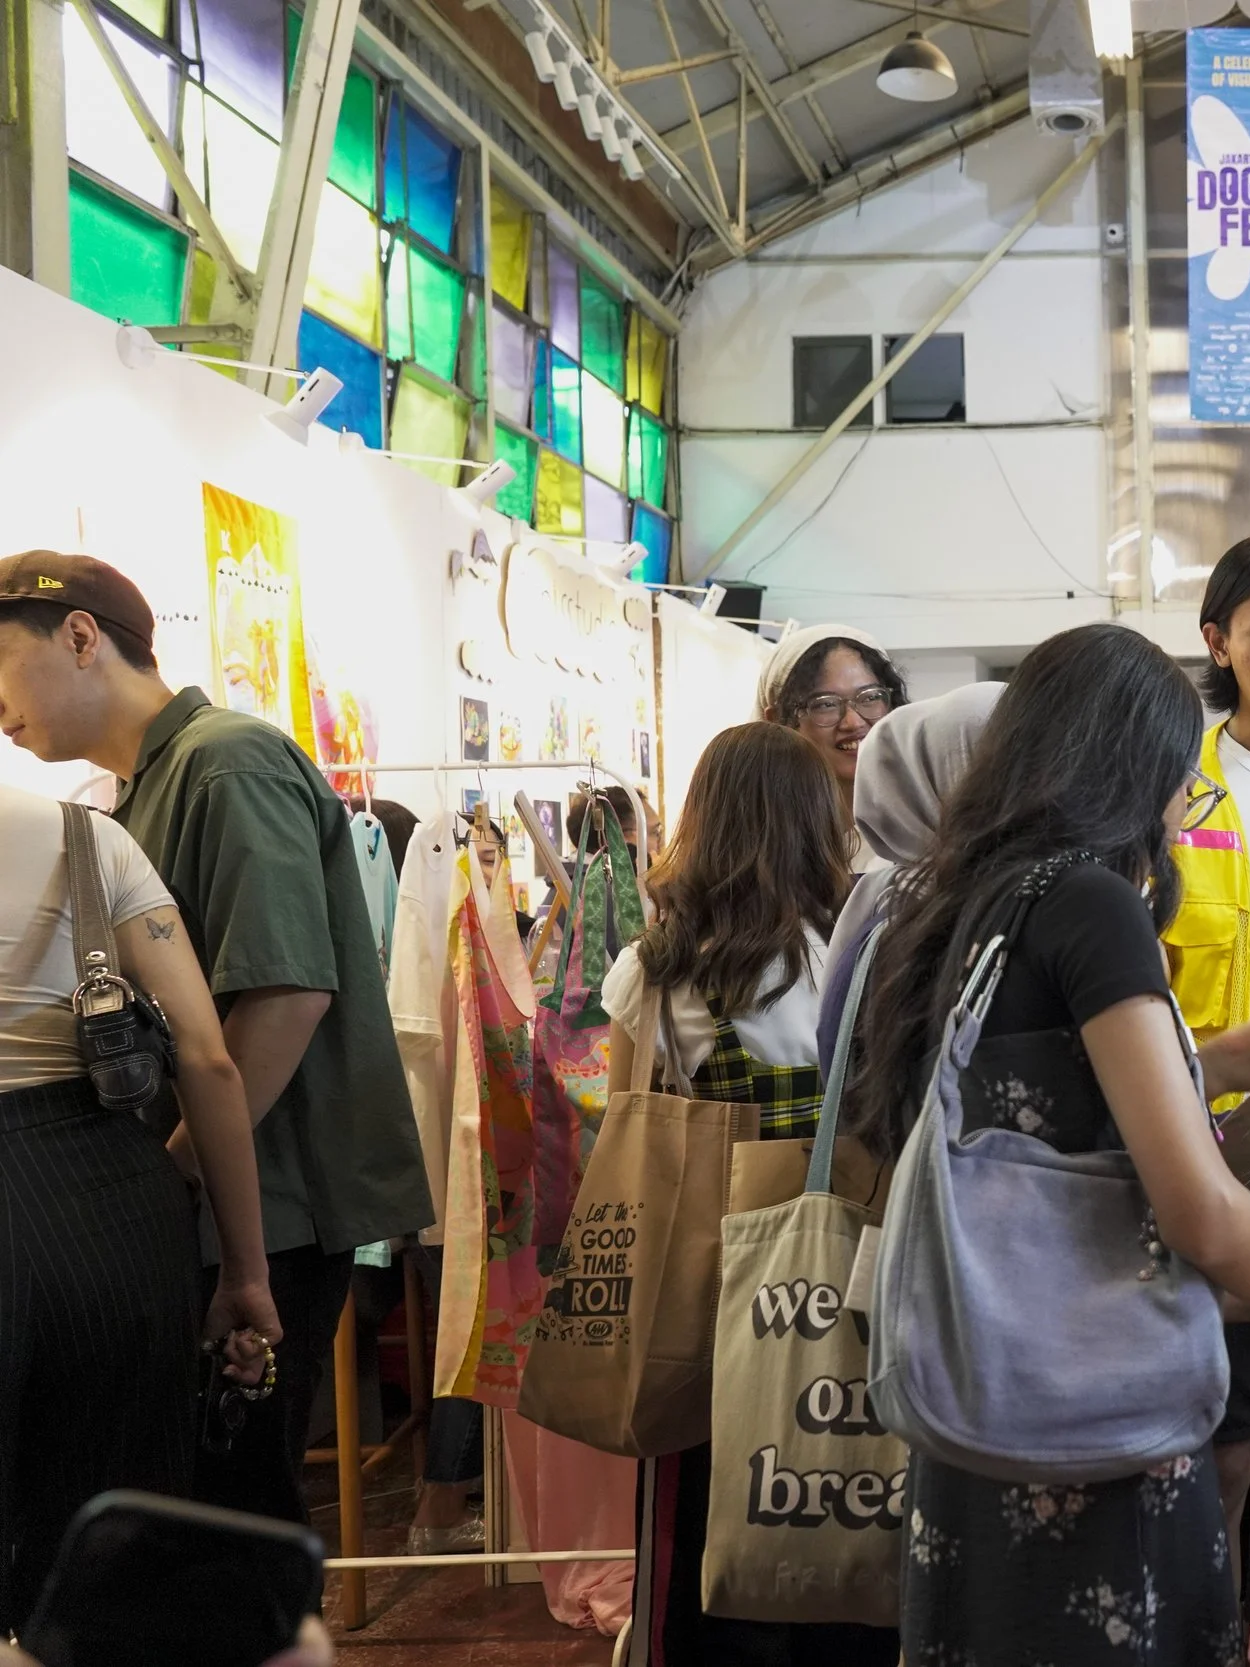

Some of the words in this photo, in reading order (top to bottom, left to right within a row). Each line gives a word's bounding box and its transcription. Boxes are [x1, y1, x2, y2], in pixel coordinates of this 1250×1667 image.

[1213, 56, 1221, 69] A
[1211, 73, 1225, 87] OF
[585, 1203, 613, 1224] Let
[580, 1227, 637, 1249] GOOD
[582, 1253, 627, 1275] TIMES
[571, 1280, 625, 1312] ROLL
[753, 1279, 840, 1340] we
